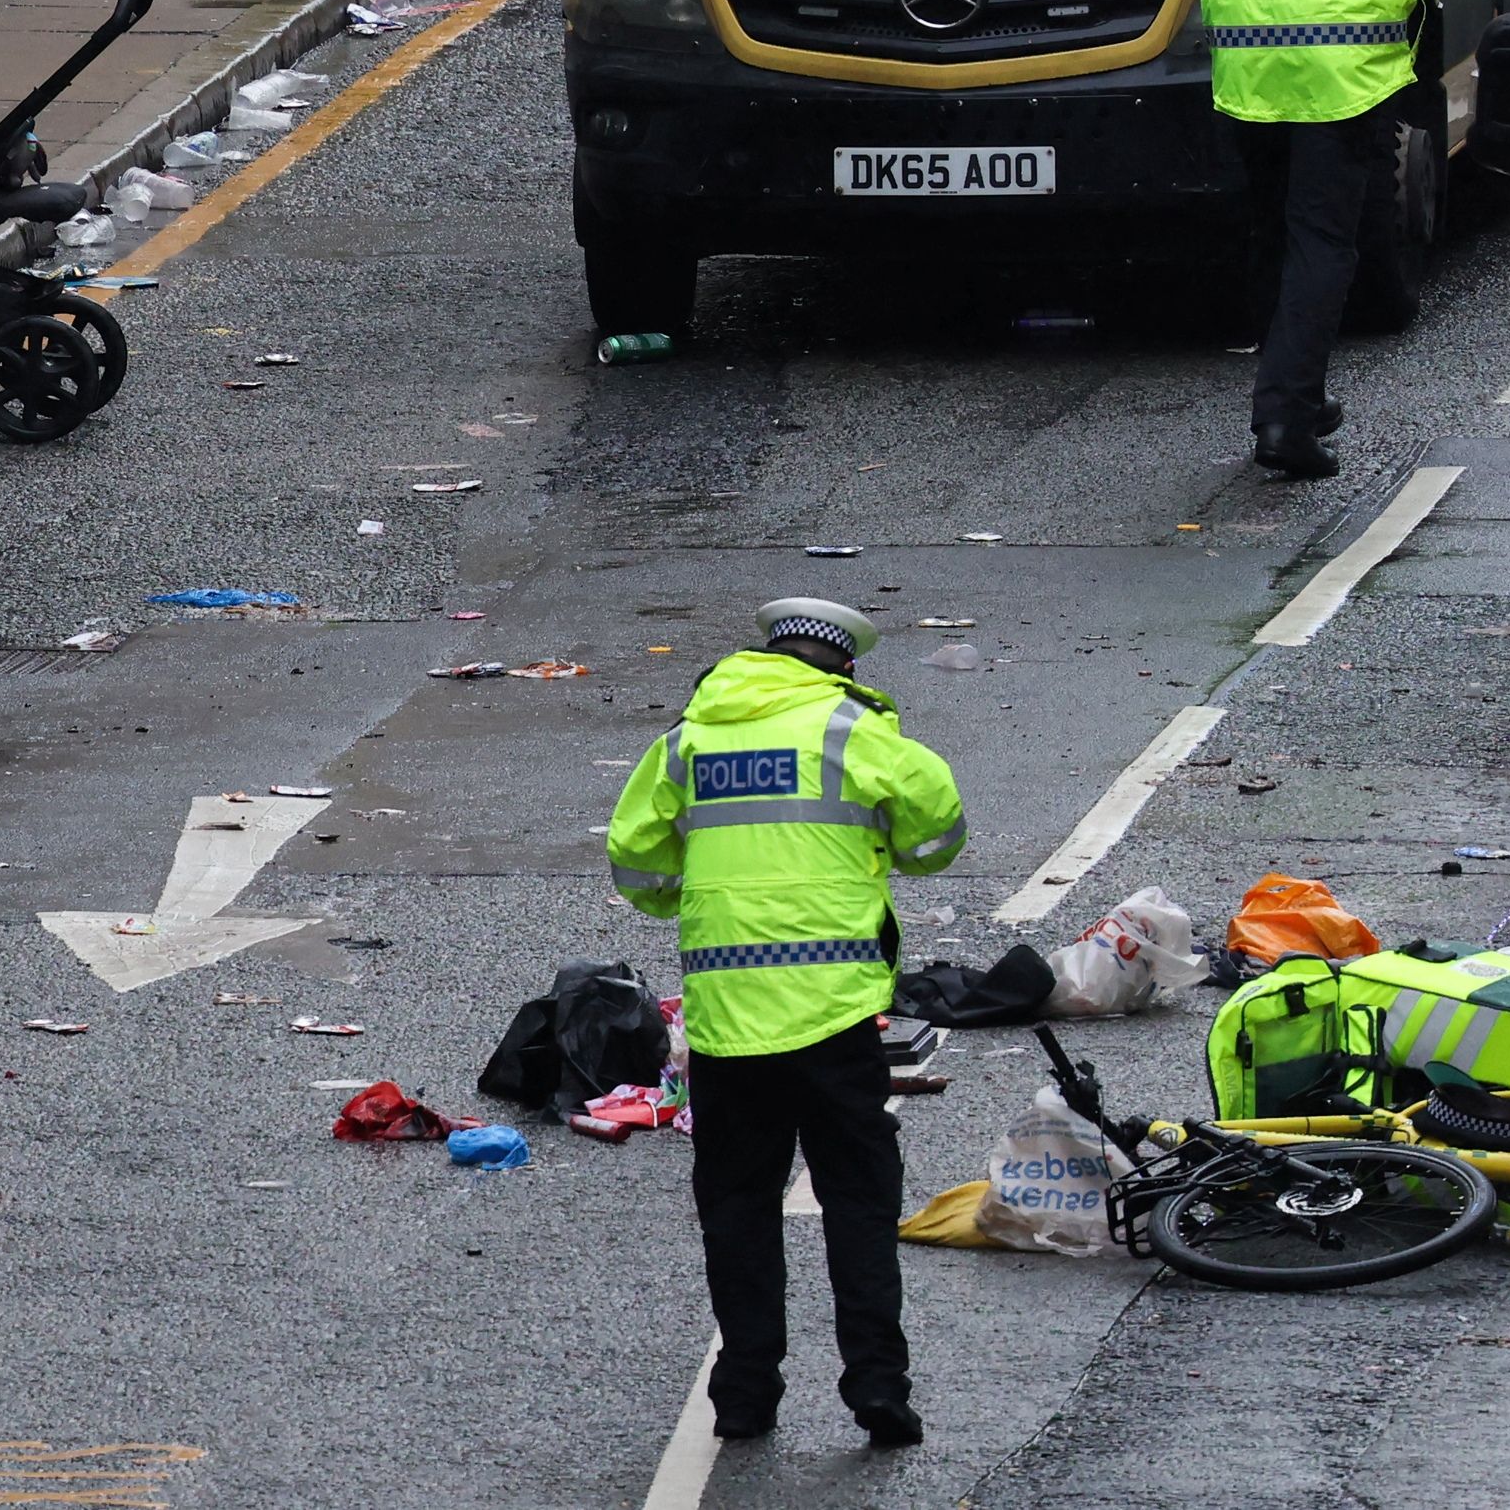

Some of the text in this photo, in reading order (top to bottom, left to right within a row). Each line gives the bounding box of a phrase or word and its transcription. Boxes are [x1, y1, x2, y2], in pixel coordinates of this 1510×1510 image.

[850, 152, 1038, 190] DK65 AOO
[695, 756, 793, 793] POLICE
